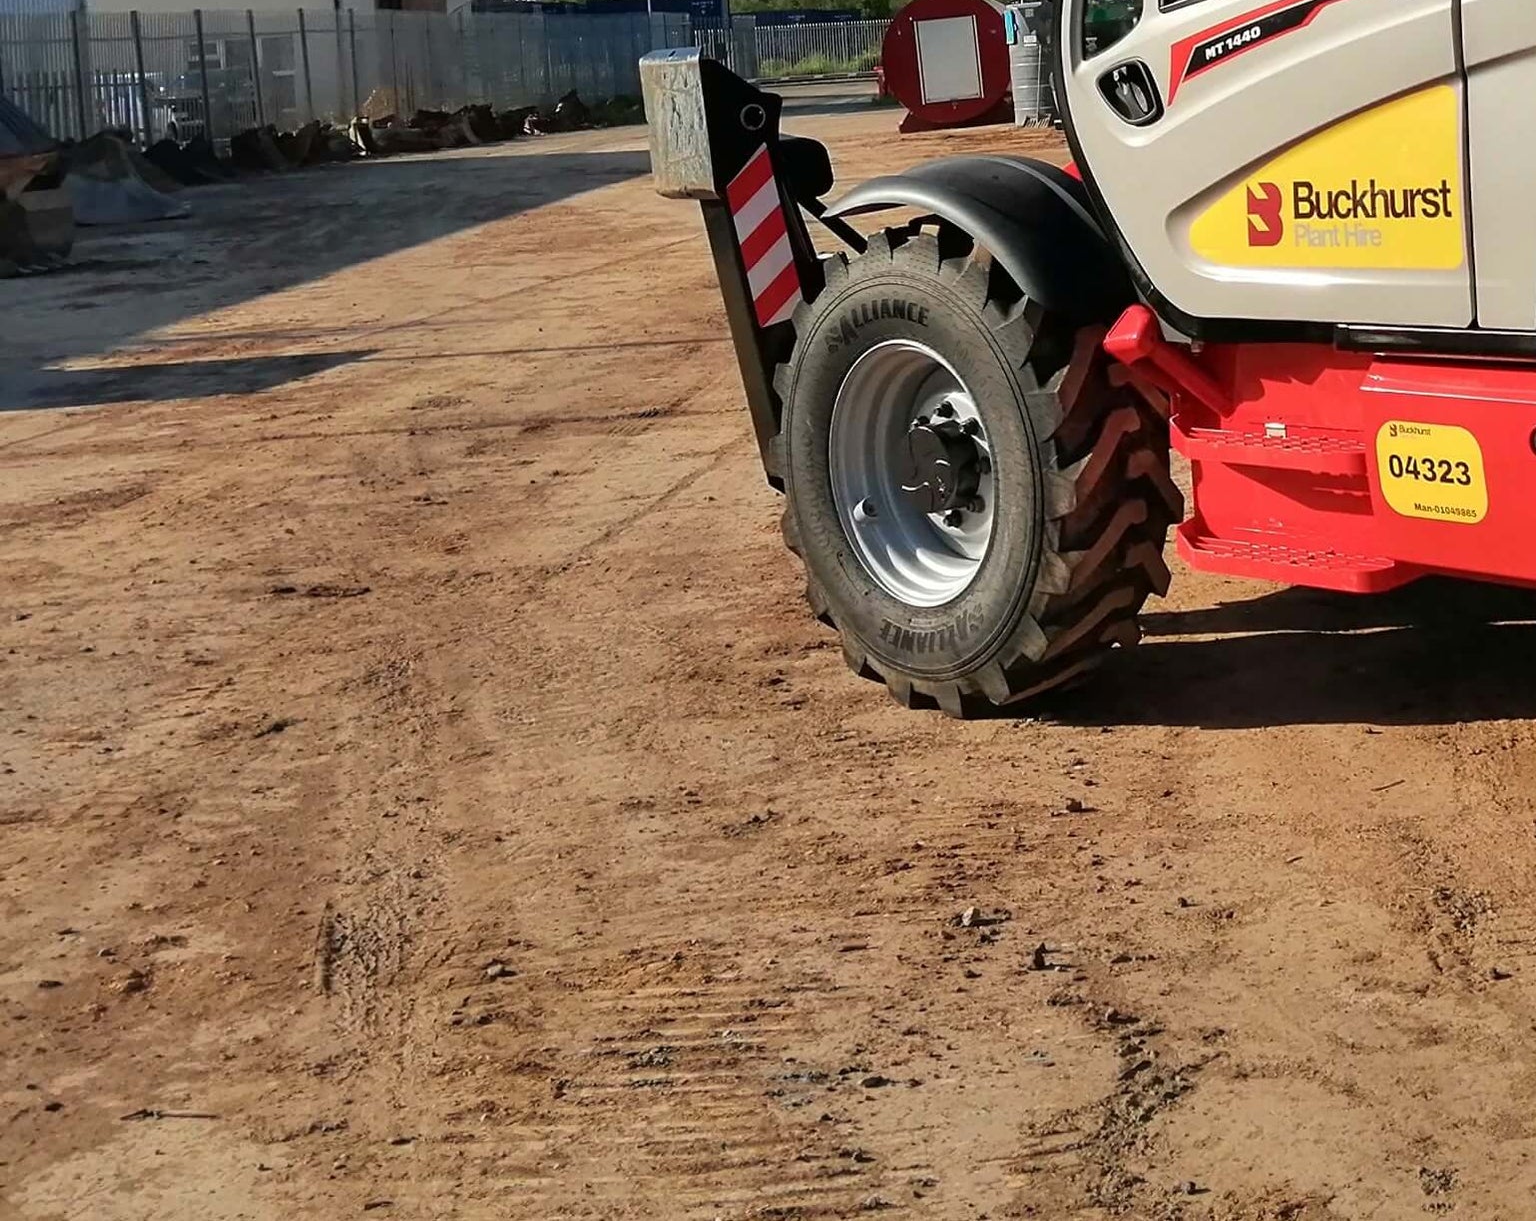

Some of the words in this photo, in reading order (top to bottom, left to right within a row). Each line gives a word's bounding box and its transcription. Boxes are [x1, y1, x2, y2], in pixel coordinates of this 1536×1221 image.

[1205, 41, 1225, 61] MT
[1225, 25, 1261, 50] 1440
[1293, 179, 1452, 219] Buckhurst
[1294, 223, 1341, 248] Plant
[1345, 222, 1382, 248] Hire
[839, 298, 930, 346] ALLIANCE
[1389, 454, 1471, 486] 04323
